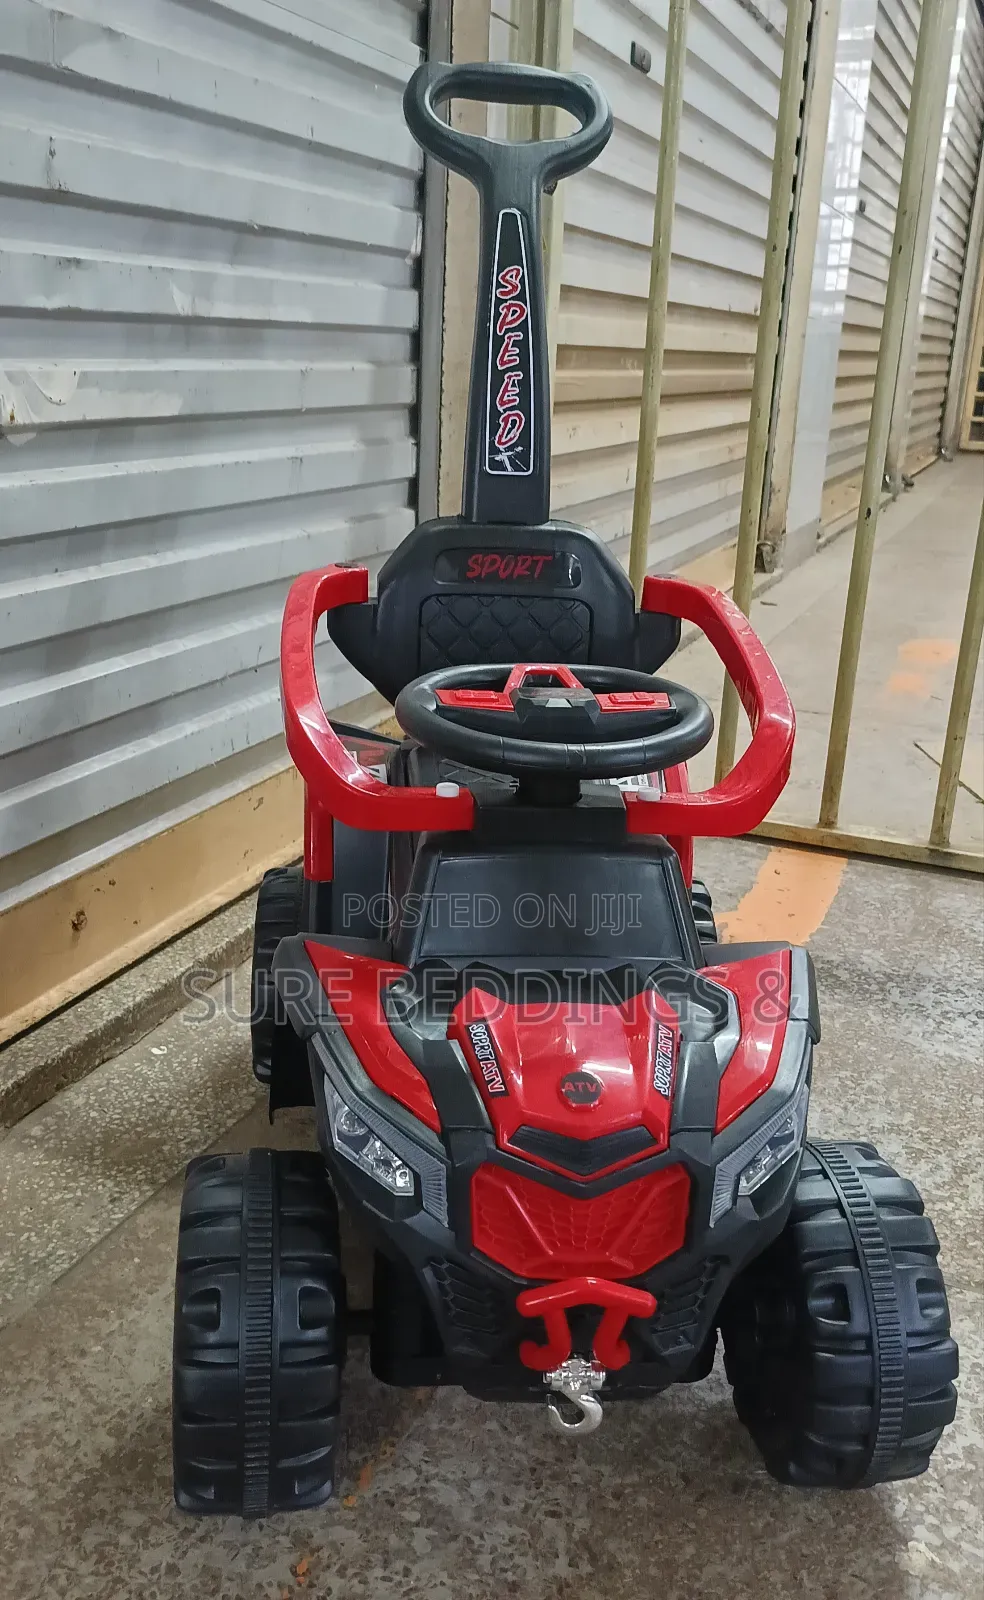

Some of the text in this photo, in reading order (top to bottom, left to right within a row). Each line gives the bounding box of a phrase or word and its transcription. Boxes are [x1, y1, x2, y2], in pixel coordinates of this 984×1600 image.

[496, 265, 527, 448] SPEED
[466, 553, 553, 579] SPORT
[563, 1081, 598, 1094] ATV
